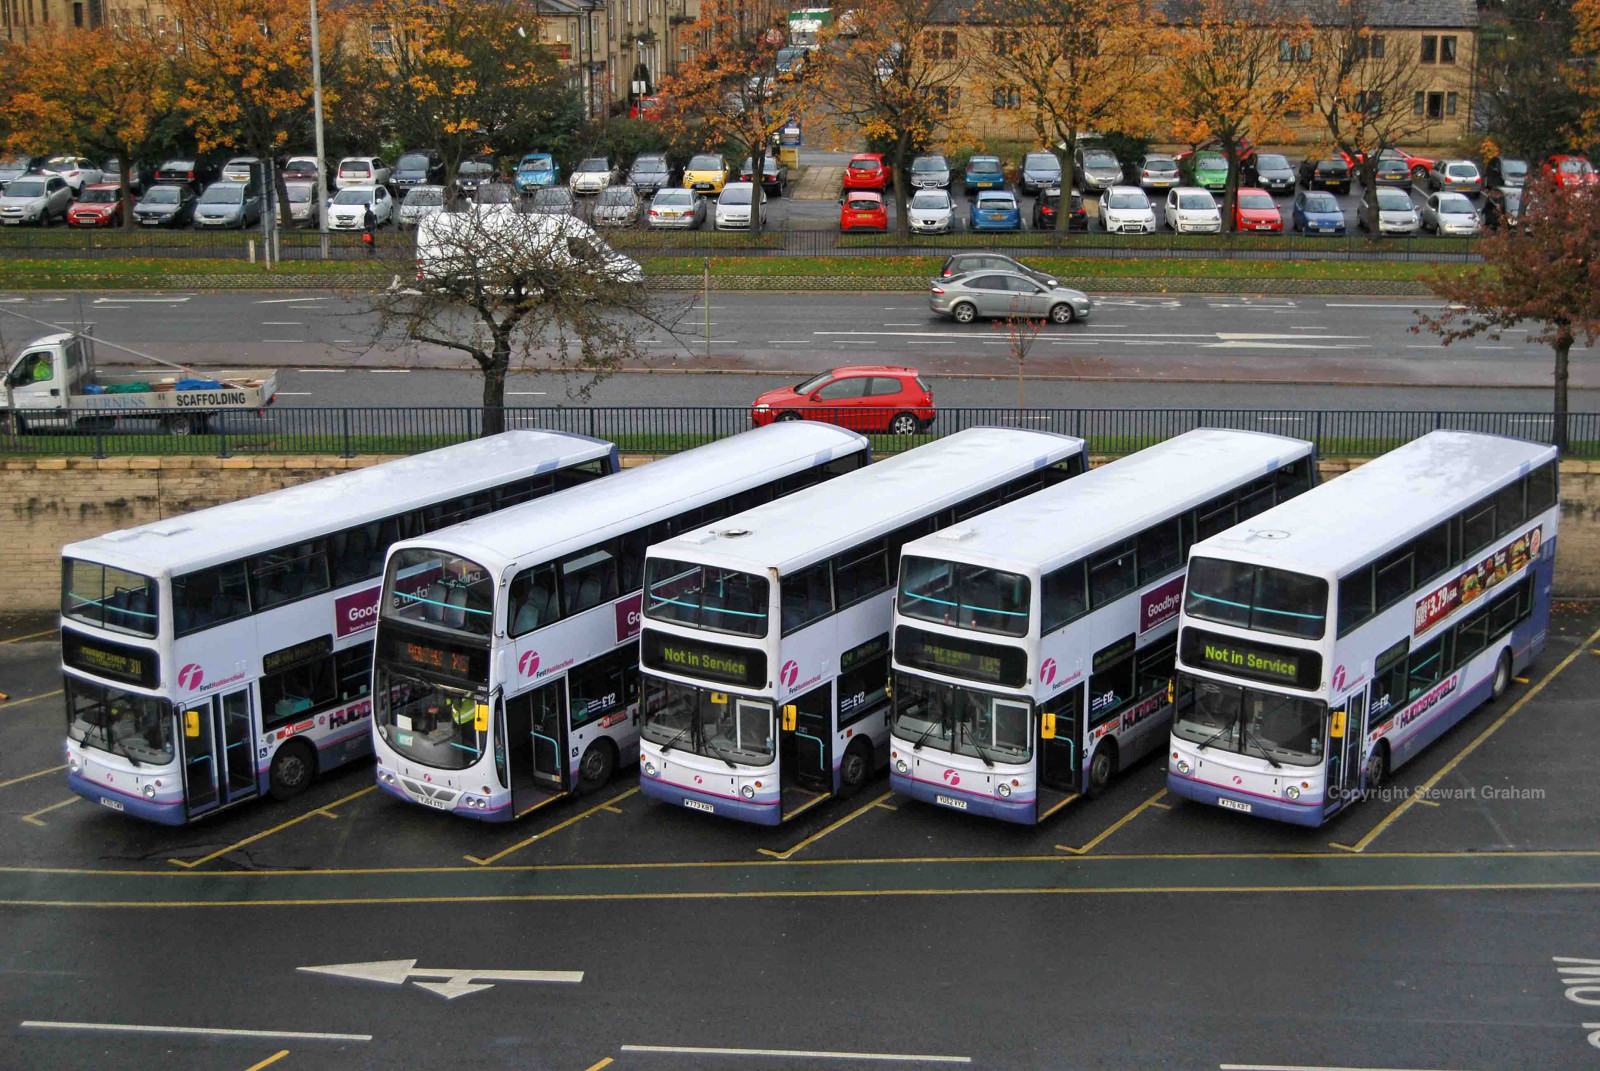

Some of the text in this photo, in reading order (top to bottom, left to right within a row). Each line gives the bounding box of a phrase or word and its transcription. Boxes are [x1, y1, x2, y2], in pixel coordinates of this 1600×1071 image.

[177, 392, 246, 407] SCAFFOLDING
[1148, 593, 1180, 617] Goodbye
[664, 647, 745, 674] Not in Service
[1205, 645, 1296, 675] Not in Service
[853, 691, 865, 707] £12
